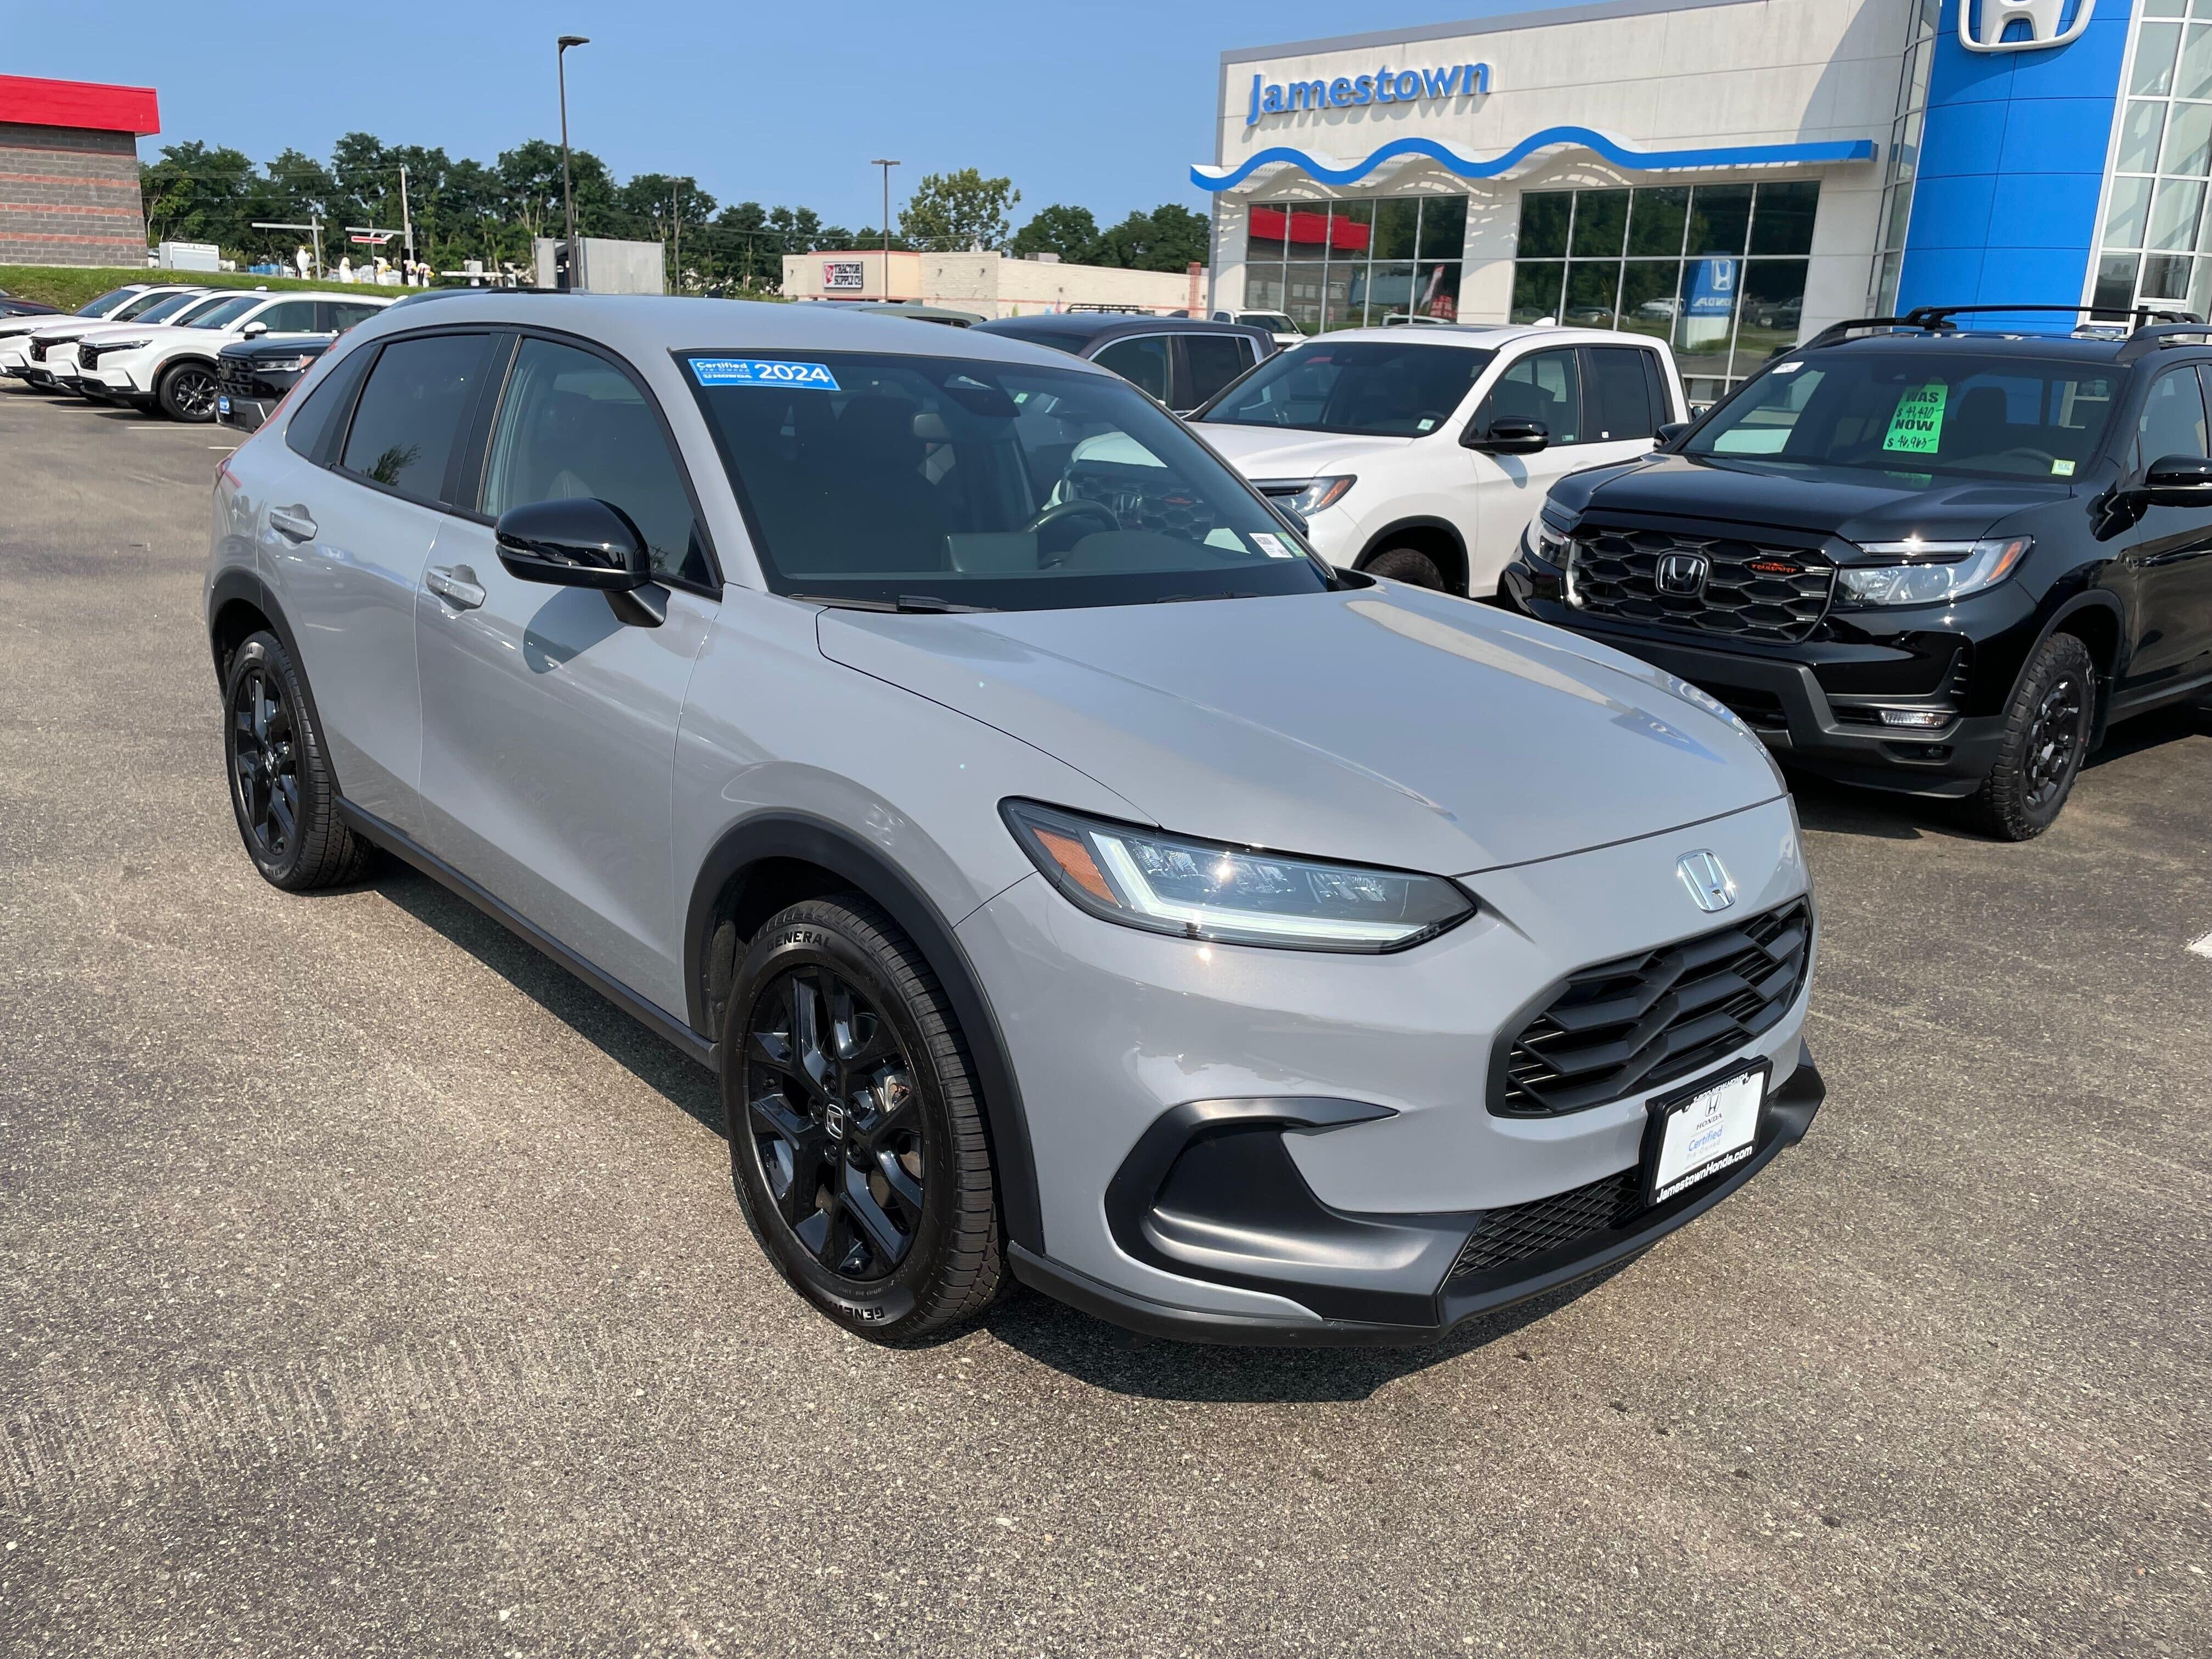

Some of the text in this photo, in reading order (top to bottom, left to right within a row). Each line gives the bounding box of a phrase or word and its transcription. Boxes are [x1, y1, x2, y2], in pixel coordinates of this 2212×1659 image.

[1246, 62, 1489, 126] Jamestown
[834, 264, 860, 274] TRACTOR
[834, 275, 853, 286] SUPPLY
[754, 364, 830, 382] 2024
[1906, 392, 1939, 403] WAS
[1894, 419, 1934, 431] NOW
[767, 931, 832, 953] GENERAL
[1696, 1113, 1723, 1131] HONDA
[1688, 1125, 1723, 1152] Certified
[1656, 1146, 1753, 1203] JamestownHonda.com
